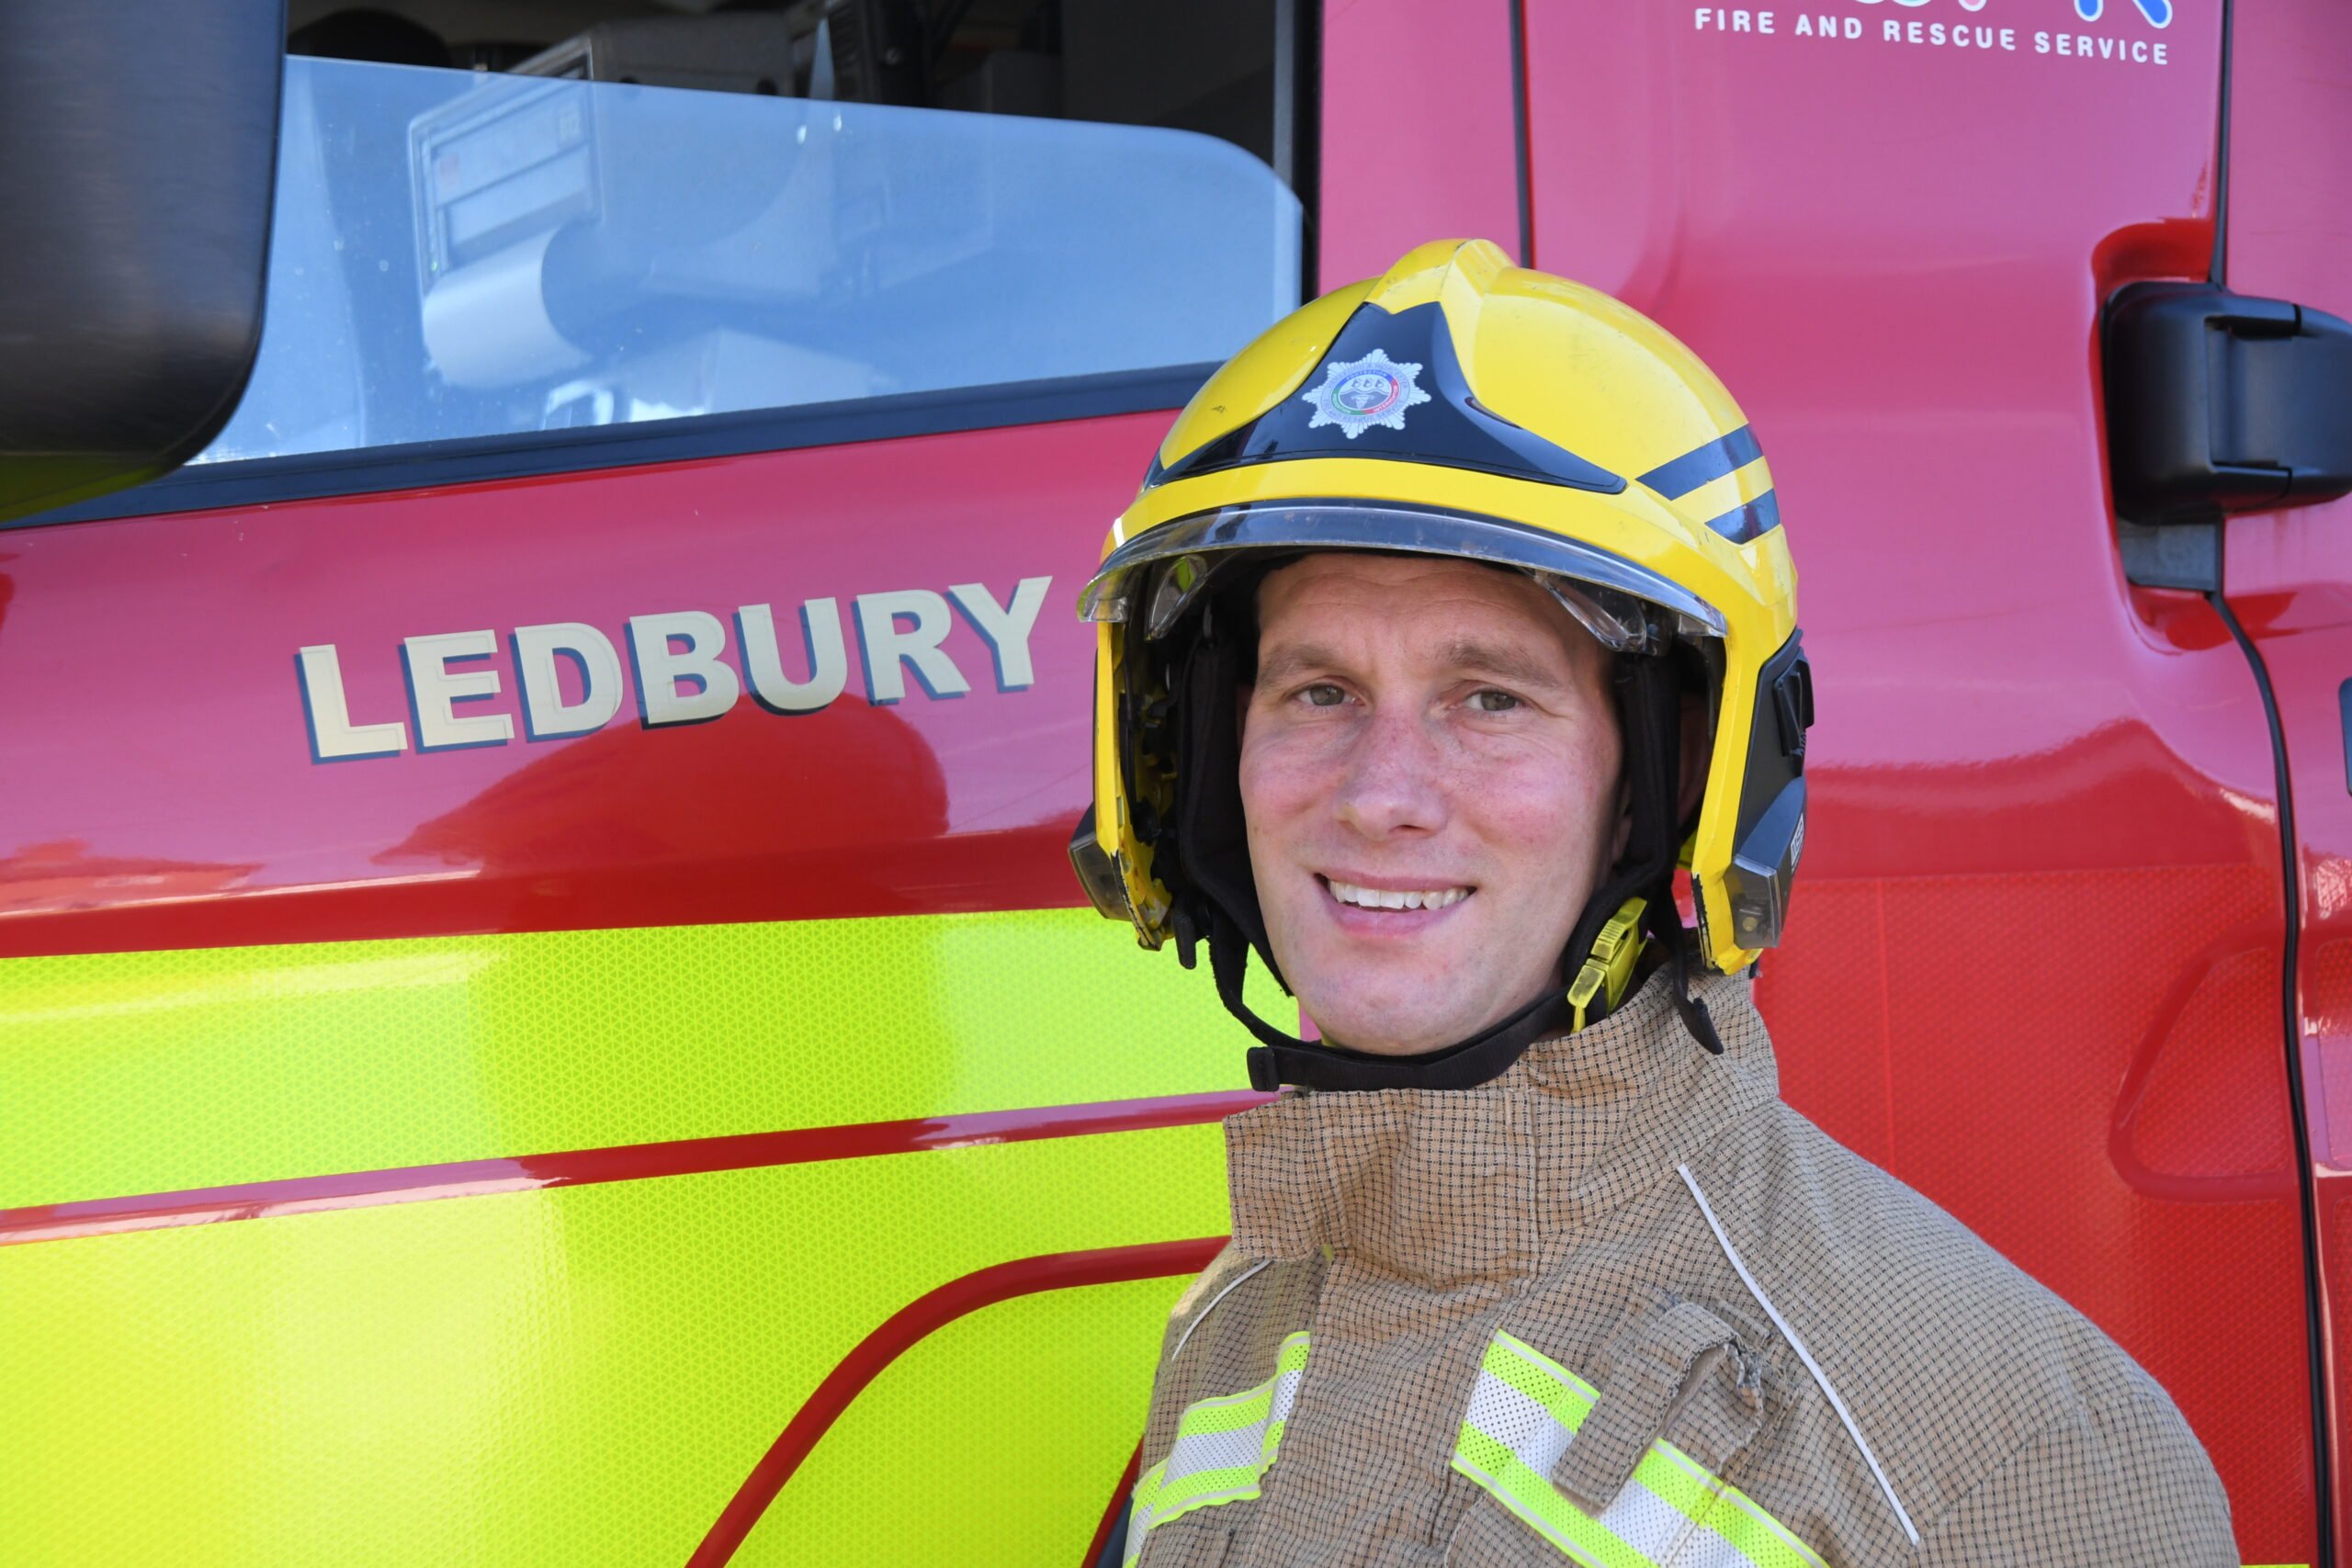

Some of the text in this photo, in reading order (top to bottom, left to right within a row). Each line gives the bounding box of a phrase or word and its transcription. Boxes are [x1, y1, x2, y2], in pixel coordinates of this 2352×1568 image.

[1694, 7, 2168, 65] FIRE AND RESCUE SERVICE
[295, 576, 1053, 763] LEDBURY
